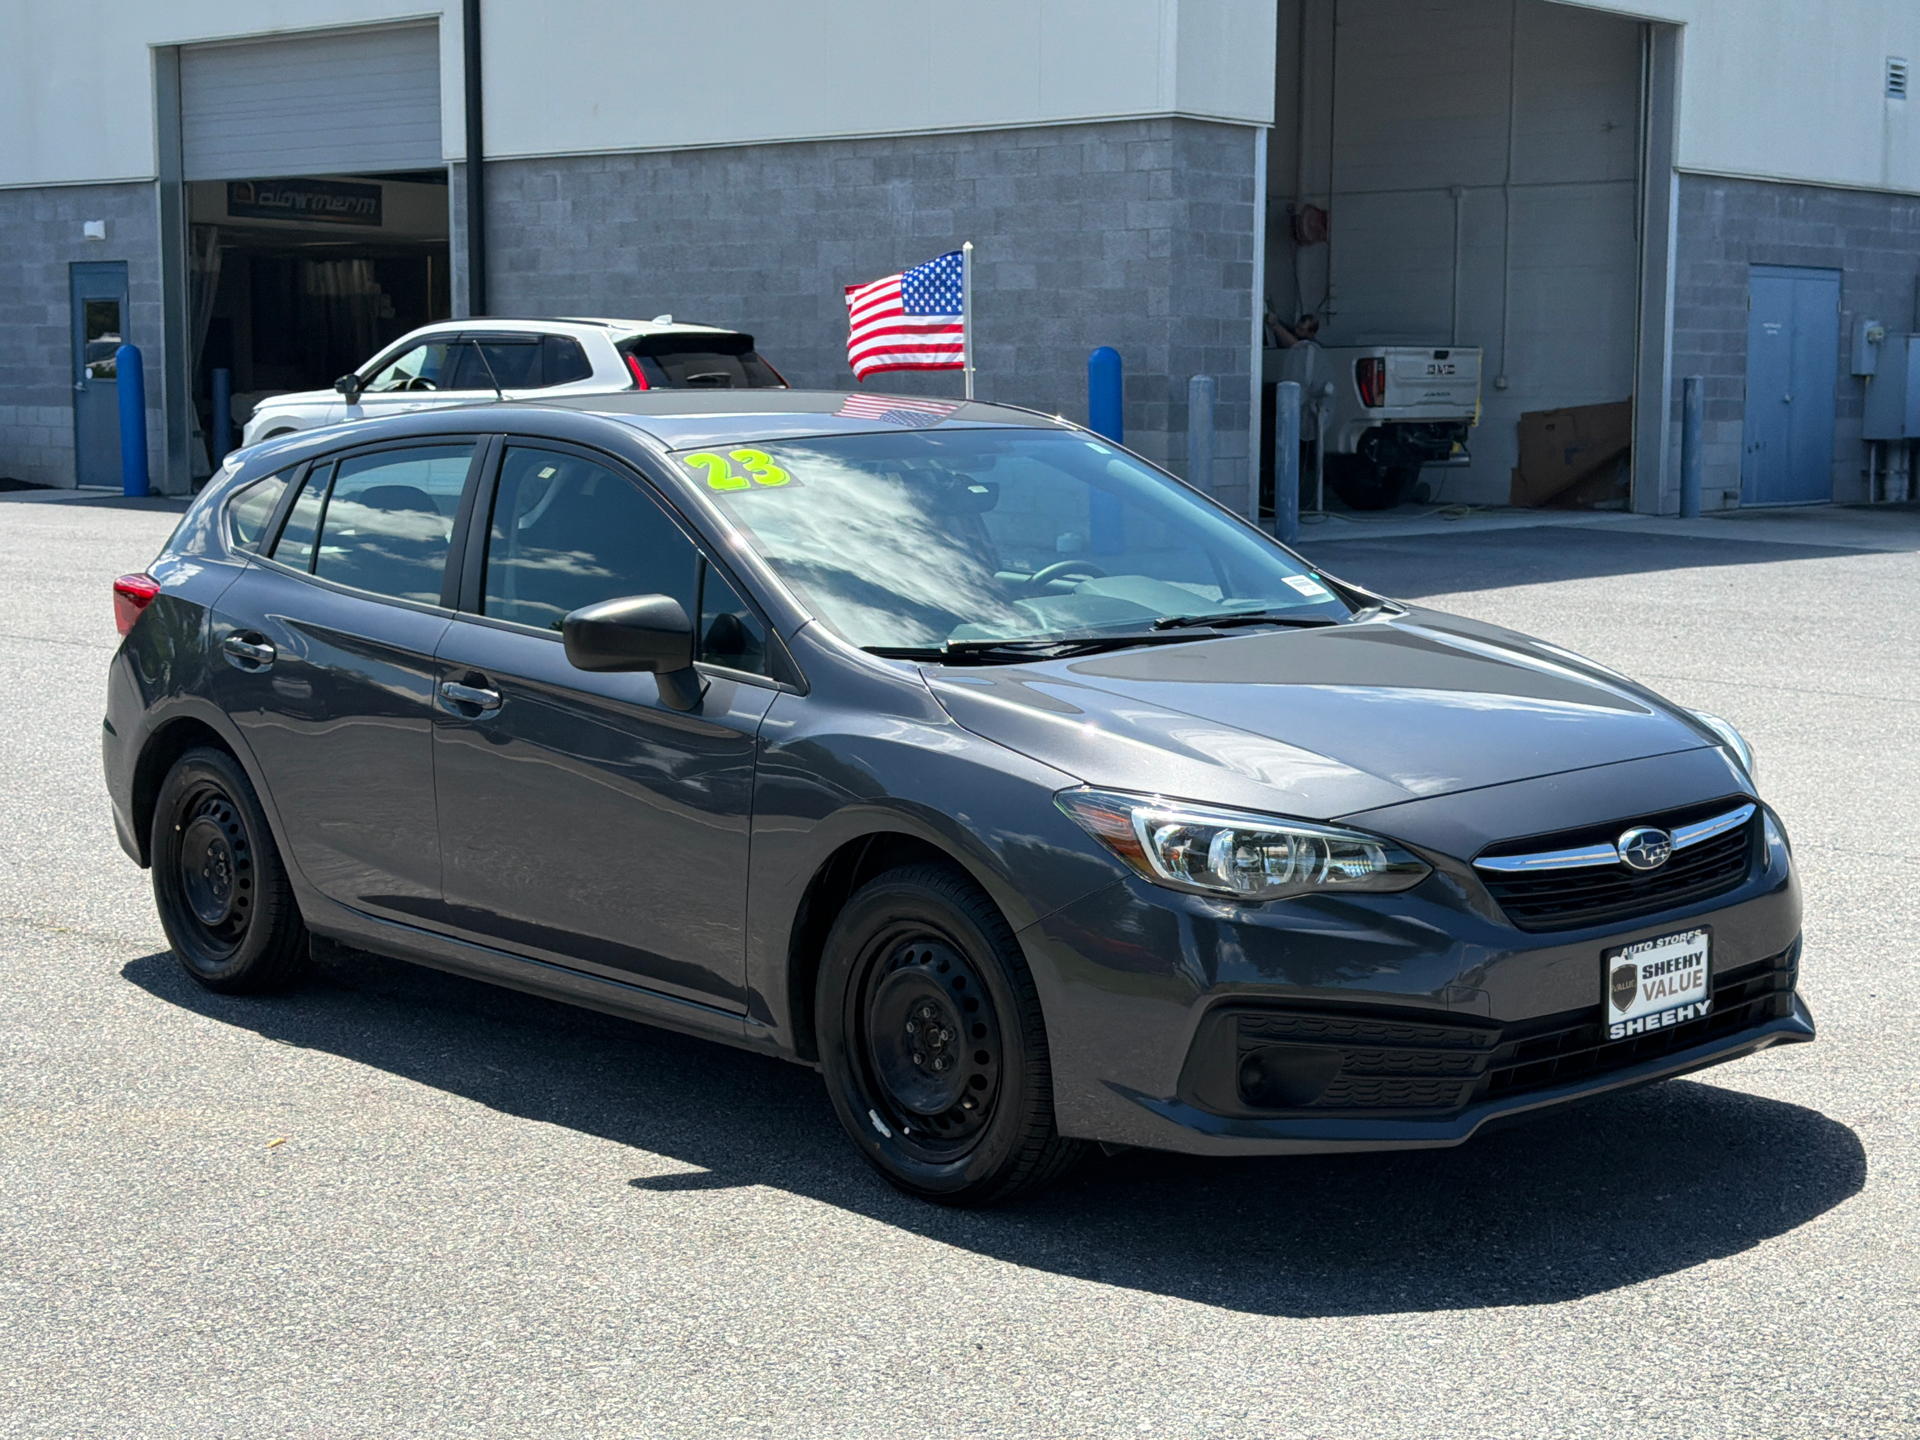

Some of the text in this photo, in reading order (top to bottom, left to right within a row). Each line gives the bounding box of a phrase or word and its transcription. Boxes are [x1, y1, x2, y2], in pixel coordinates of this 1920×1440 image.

[683, 449, 791, 491] 23
[1621, 929, 1702, 957] AUTO STORES
[1642, 951, 1703, 980] SHEEHY
[1642, 969, 1703, 1001] VALUE
[1610, 999, 1711, 1040] SHEEHY
